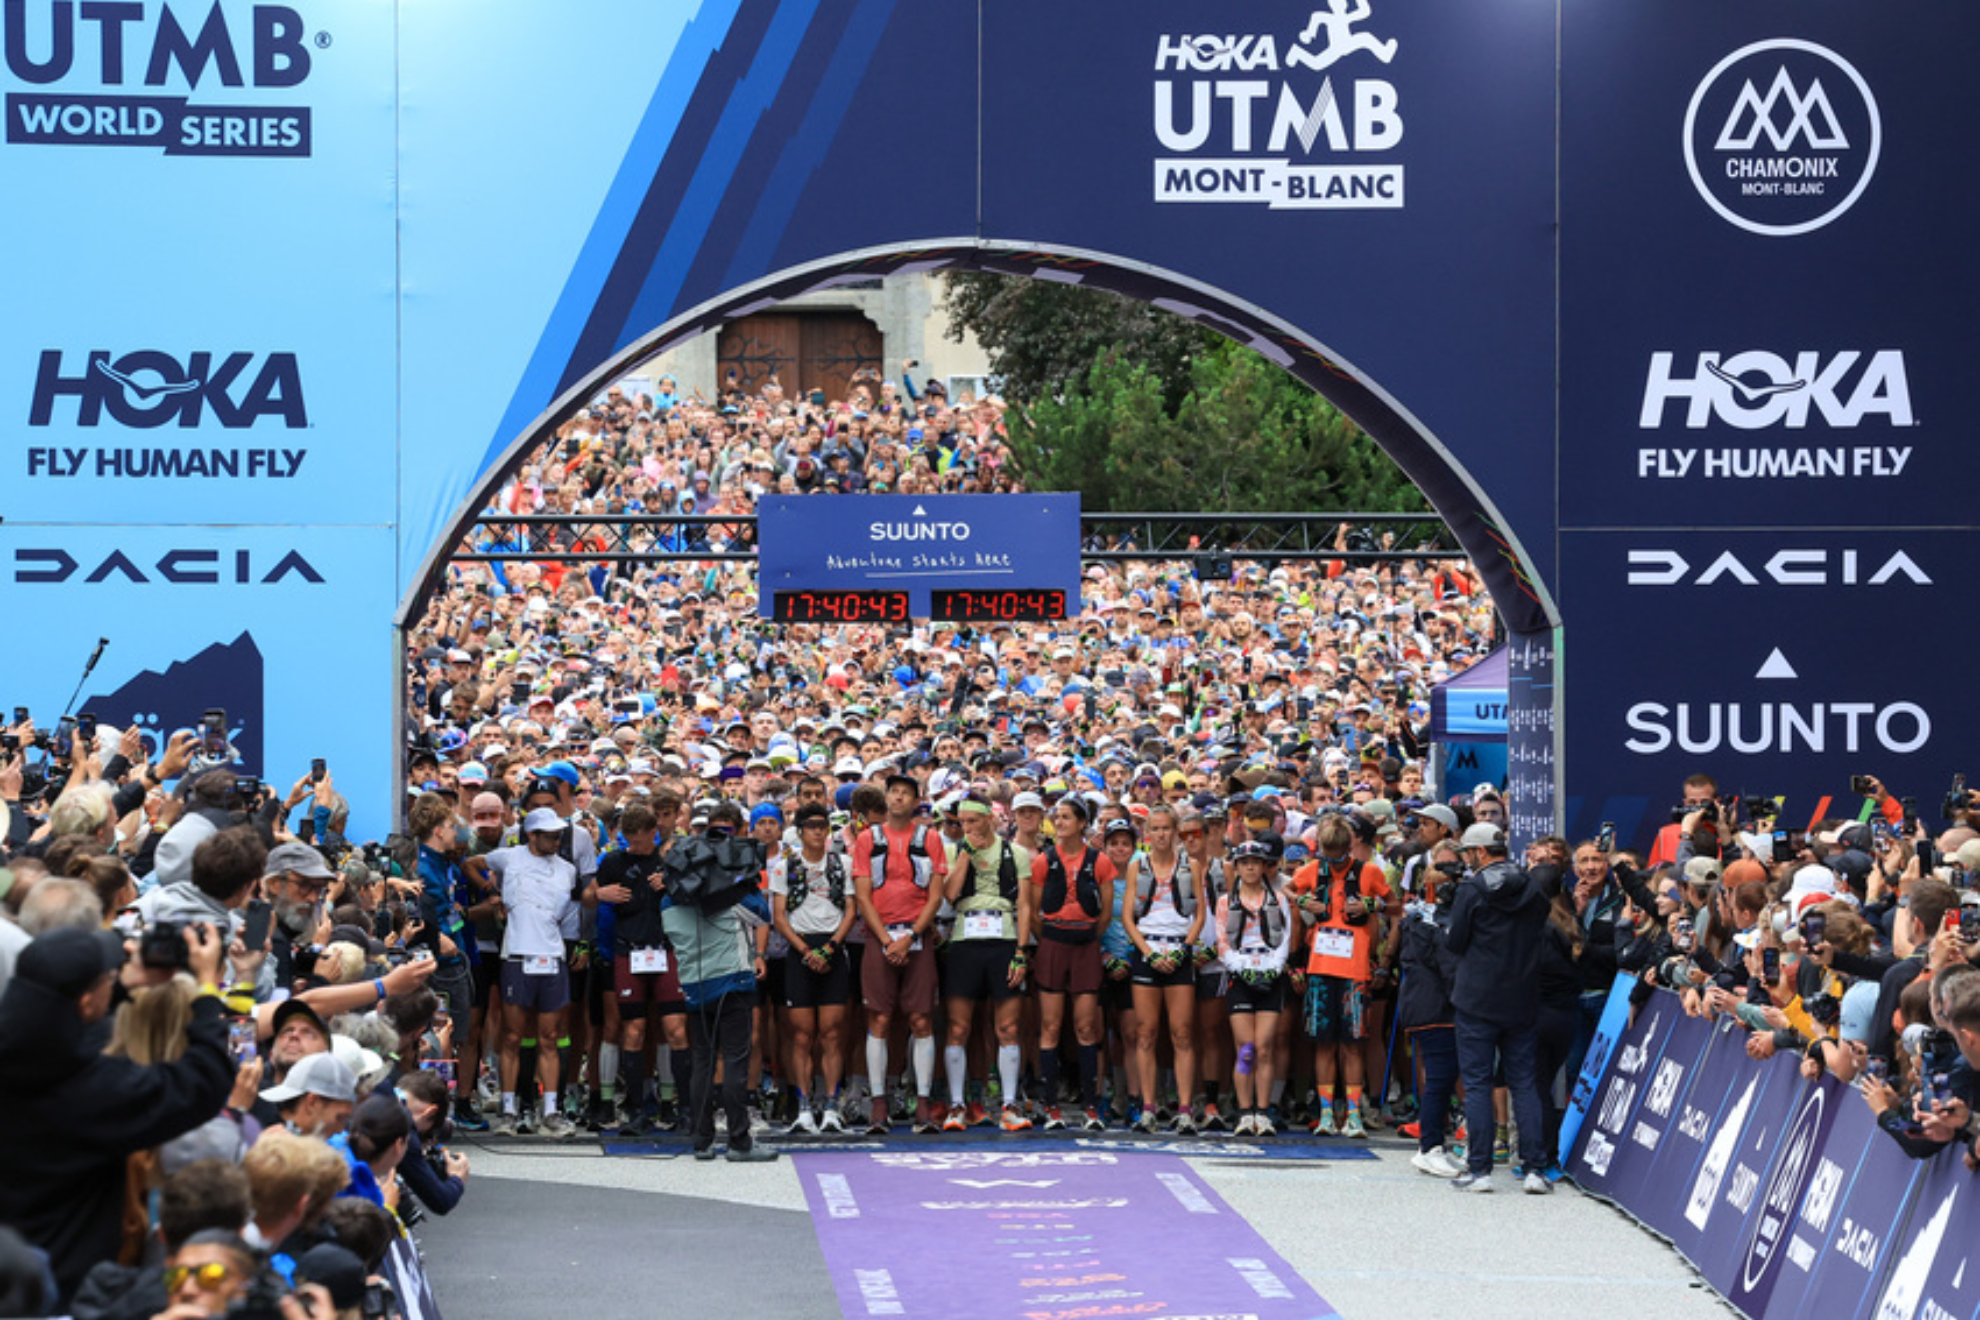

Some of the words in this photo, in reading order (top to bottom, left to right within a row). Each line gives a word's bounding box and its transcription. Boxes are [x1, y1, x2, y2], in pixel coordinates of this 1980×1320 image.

[1155, 35, 1279, 71] HOKA
[18, 104, 164, 136] WORLD
[181, 117, 301, 147] SERIES
[1155, 75, 1403, 154] UTMB
[1164, 168, 1395, 200] MONT-BLANC
[1725, 157, 1839, 178] CHAMONIX
[1741, 182, 1825, 196] MONT-BLANC
[28, 350, 308, 428] HOKA
[1639, 350, 1914, 429] HOKA
[28, 447, 88, 477] FLY
[96, 448, 239, 478] HUMAN
[247, 449, 308, 478] FLY
[1639, 448, 1698, 478] FLY
[1704, 448, 1846, 478] HUMAN
[1853, 446, 1913, 476] FLY
[869, 522, 971, 541] SUUNTO
[15, 549, 326, 584] DACIA
[1628, 550, 1934, 585] DACIA
[787, 593, 908, 620] 17:40:43
[945, 592, 1066, 619] 17:40:43
[1624, 701, 1932, 753] SUUNTO
